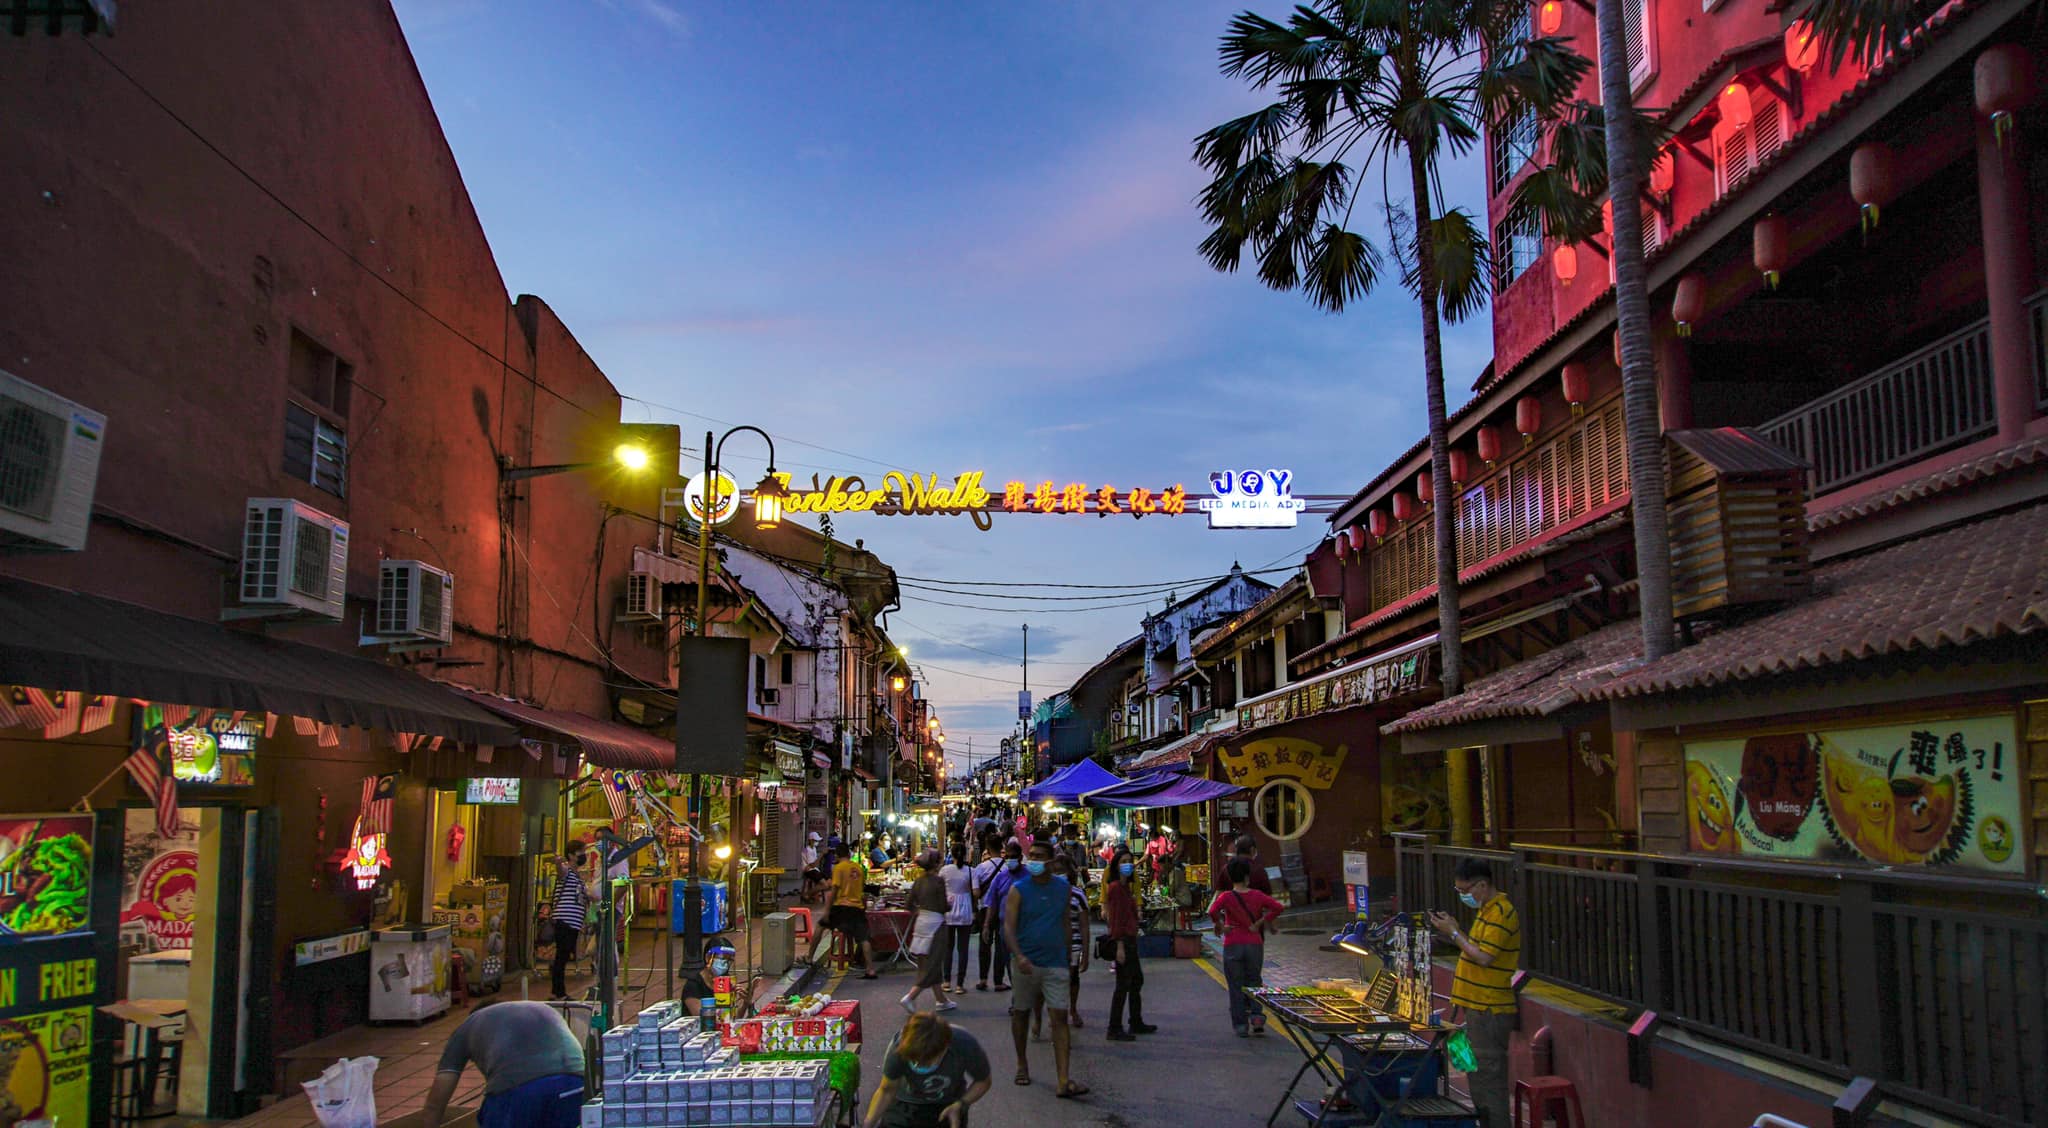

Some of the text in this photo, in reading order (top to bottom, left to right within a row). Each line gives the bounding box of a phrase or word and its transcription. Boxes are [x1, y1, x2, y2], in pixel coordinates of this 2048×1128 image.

[883, 470, 990, 511] Walk
[1213, 470, 1289, 497] JOY
[1201, 500, 1224, 509] LED
[1231, 500, 1270, 509] MEDIA
[219, 735, 256, 751] SHAKE
[147, 920, 194, 935] MADA
[40, 958, 96, 1001] FRIED
